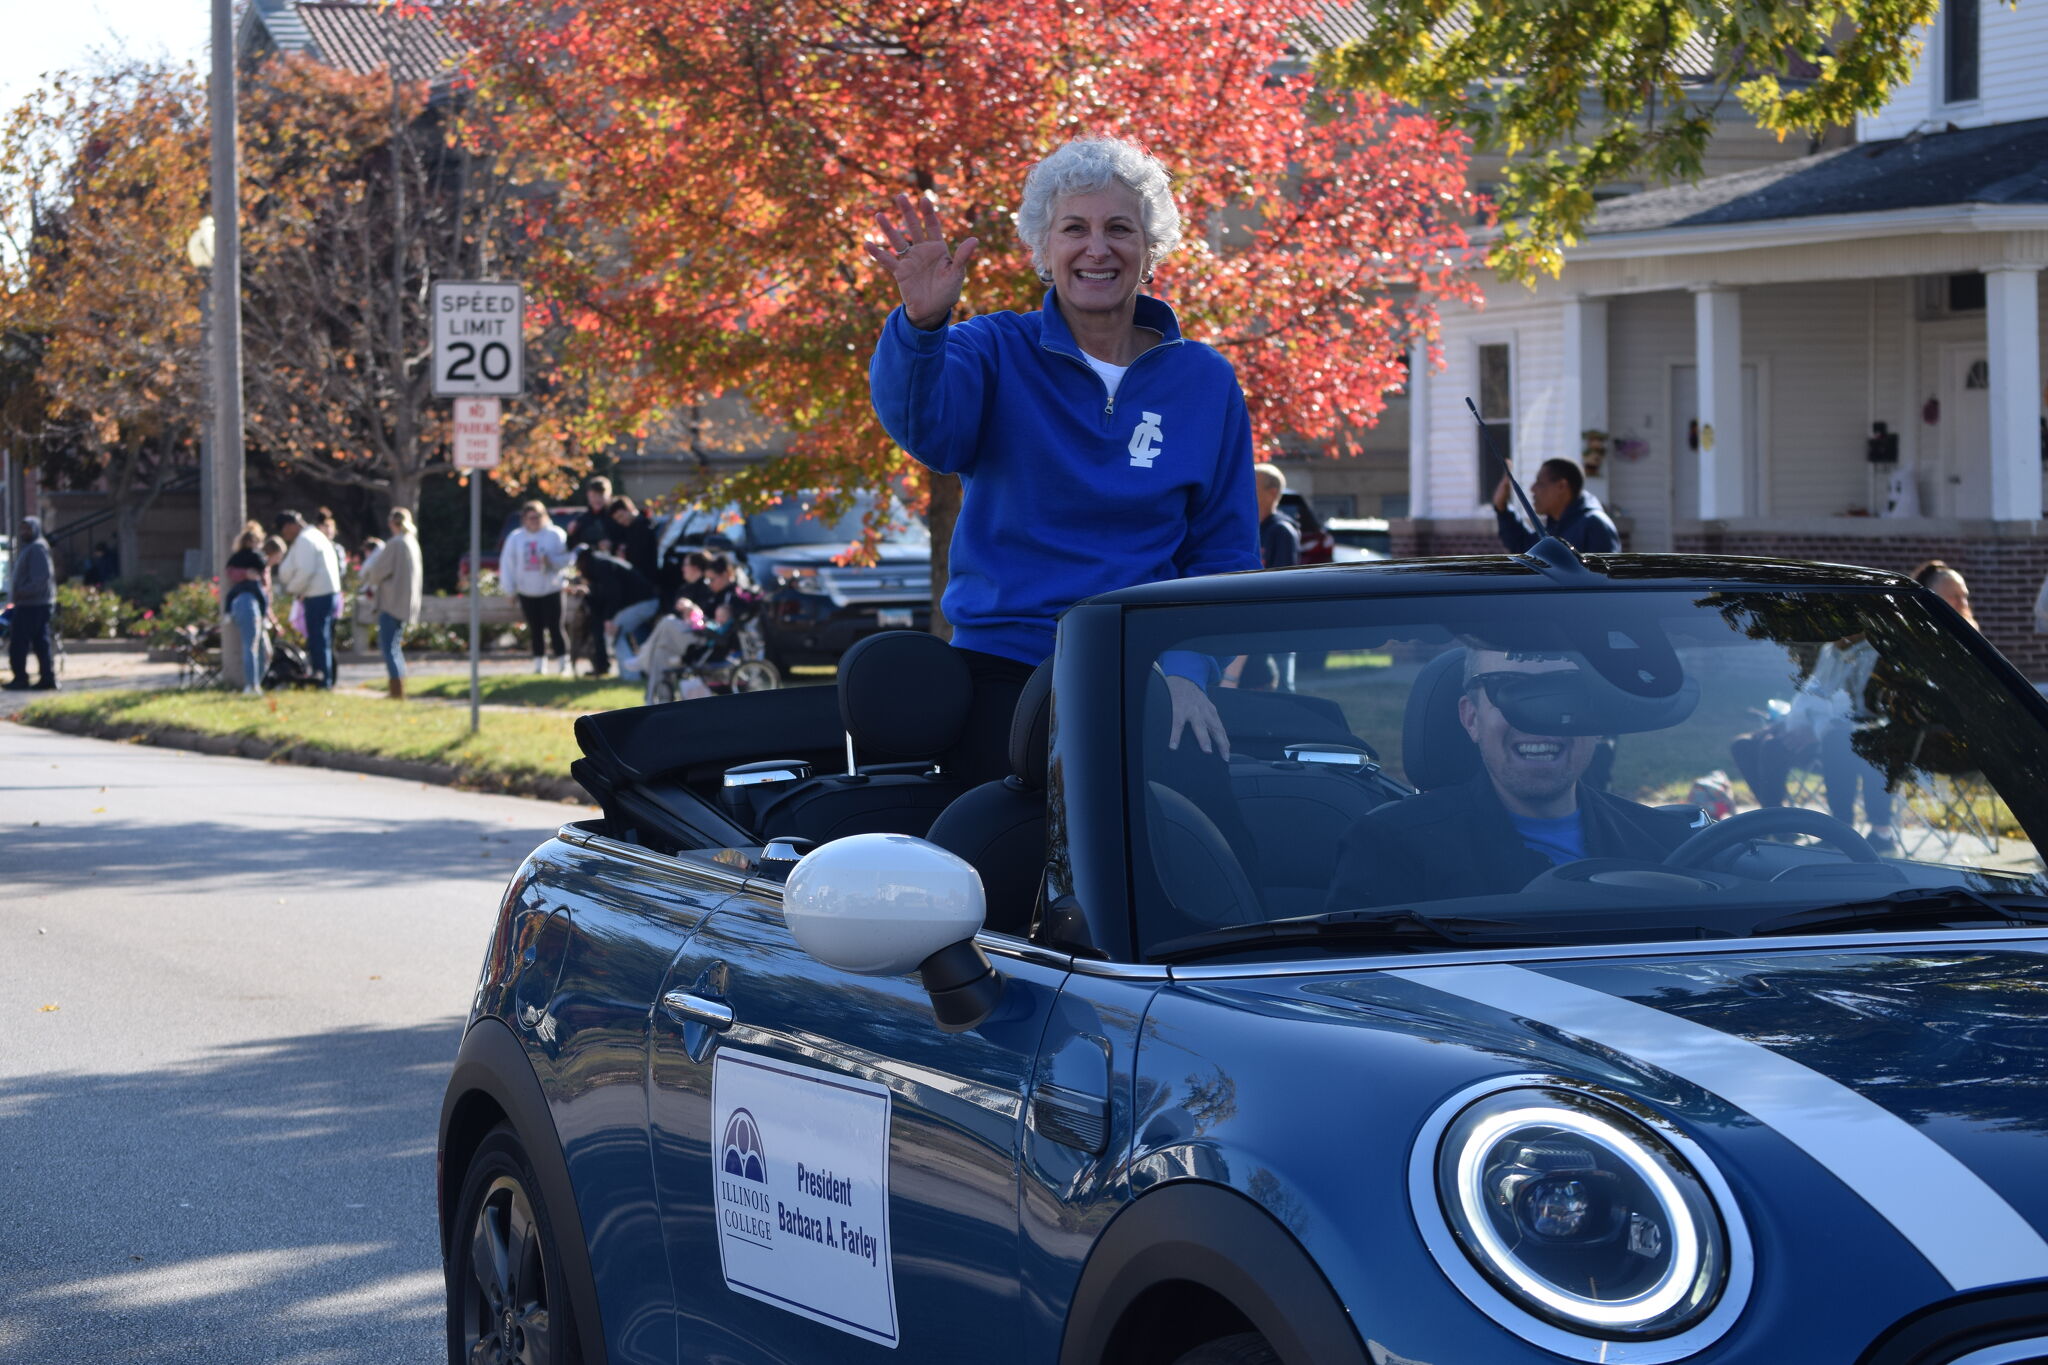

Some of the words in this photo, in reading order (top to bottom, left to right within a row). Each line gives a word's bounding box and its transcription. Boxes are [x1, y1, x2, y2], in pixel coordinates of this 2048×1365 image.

[441, 296, 514, 313] SPEED
[450, 319, 506, 335] LIMIT
[446, 342, 511, 381] 20
[469, 403, 486, 418] NO
[456, 422, 497, 435] PARKING
[721, 1181, 770, 1214] ILLINOIS
[797, 1162, 852, 1207] President
[724, 1208, 772, 1241] COLLEGE
[778, 1200, 823, 1244] Barbara
[826, 1216, 838, 1249] A.
[841, 1221, 877, 1268] Farley
